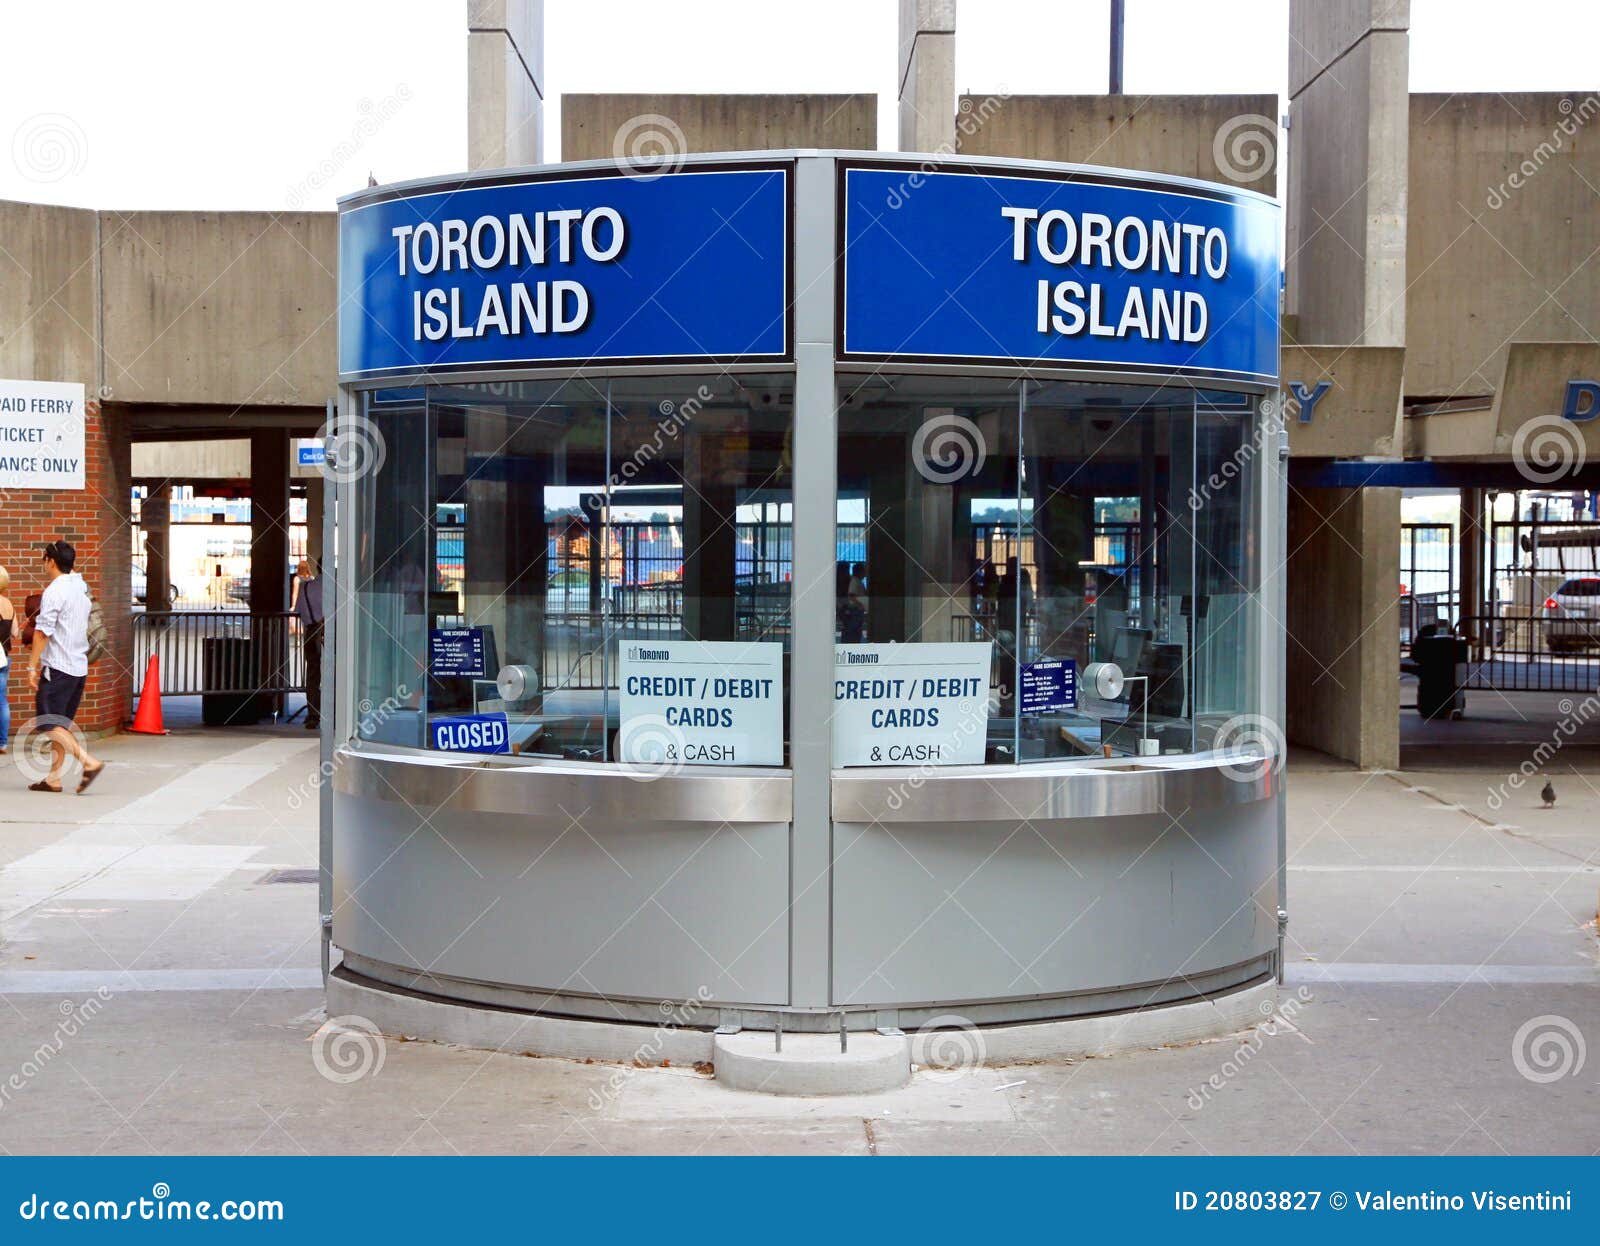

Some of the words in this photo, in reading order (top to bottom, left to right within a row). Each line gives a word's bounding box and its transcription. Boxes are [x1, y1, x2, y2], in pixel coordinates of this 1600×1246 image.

[392, 206, 625, 276] TORONTO
[1001, 206, 1228, 280] TORONTO
[413, 279, 590, 341] ISLAND
[1037, 279, 1208, 343] ISLAND
[0, 397, 26, 412] AID
[31, 398, 74, 414] FERRY
[42, 458, 78, 473] ONLY
[639, 648, 670, 661] TORONTO
[847, 652, 879, 664] TORONTO
[627, 676, 696, 697] CREDIT
[701, 678, 709, 700] /
[714, 678, 773, 699] DEBIT
[835, 679, 905, 700] CREDIT
[909, 679, 917, 701] /
[922, 678, 981, 698] DEBIT
[666, 706, 733, 728] CARDS
[871, 707, 939, 729] CARDS
[437, 721, 504, 750] CLOSED
[666, 743, 678, 760] &
[683, 744, 735, 761] CASH
[870, 746, 882, 761] &
[888, 744, 941, 761] CASH
